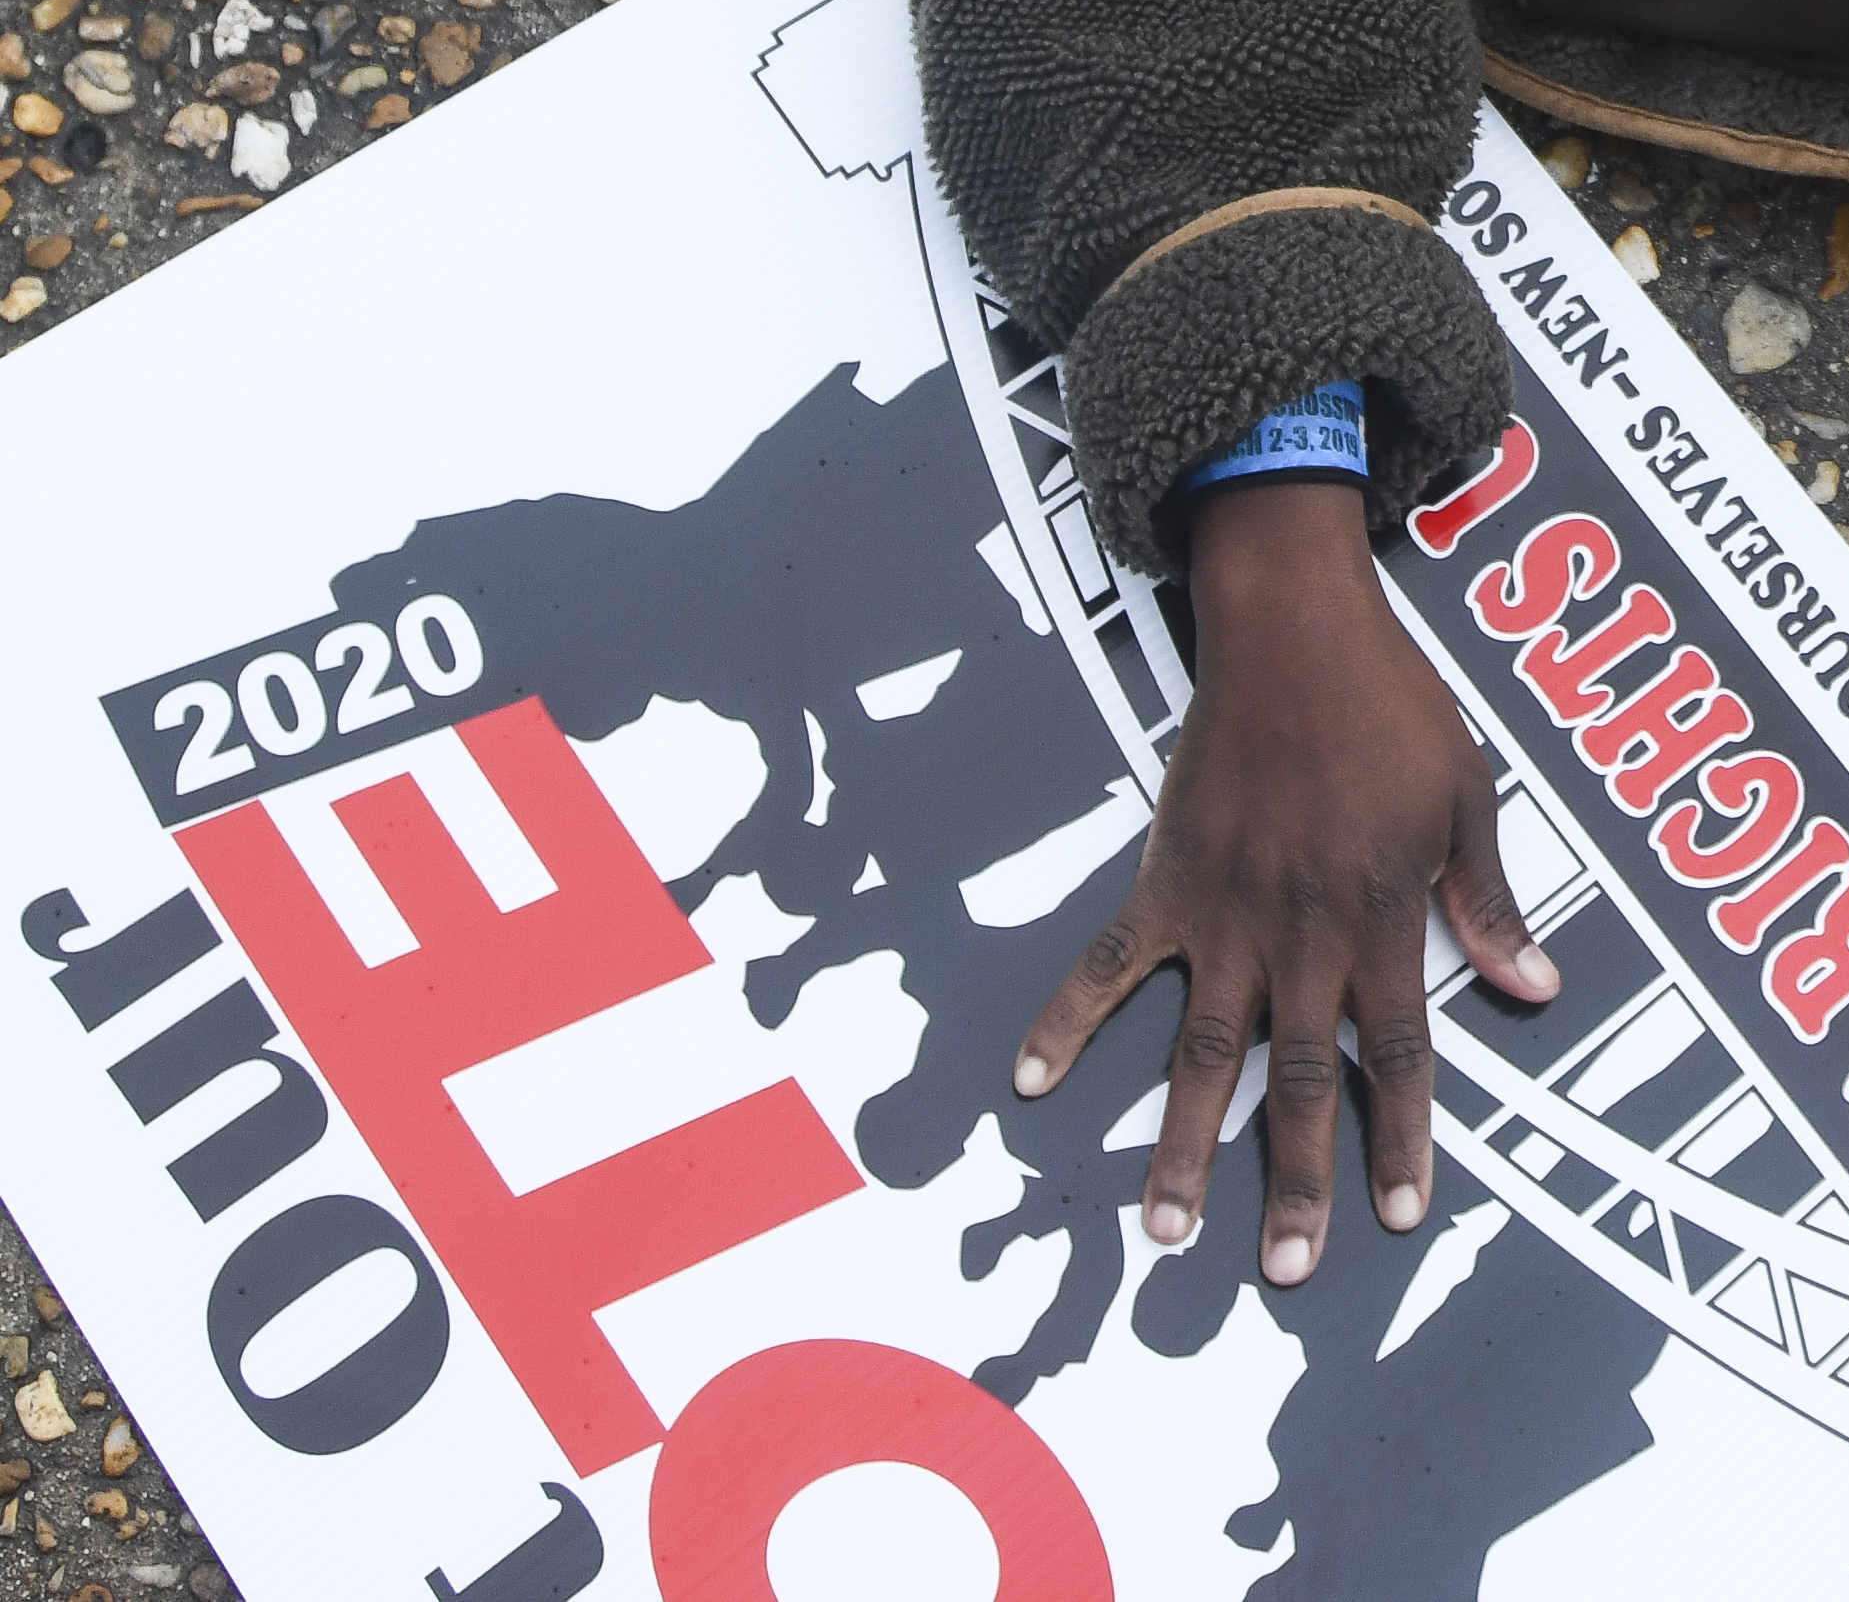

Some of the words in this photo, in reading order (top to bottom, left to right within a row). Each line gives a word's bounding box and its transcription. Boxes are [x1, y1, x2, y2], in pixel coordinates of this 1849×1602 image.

[152, 592, 484, 795] 2020
[20, 886, 450, 1456] Our
[172, 694, 1116, 1602] OTE
